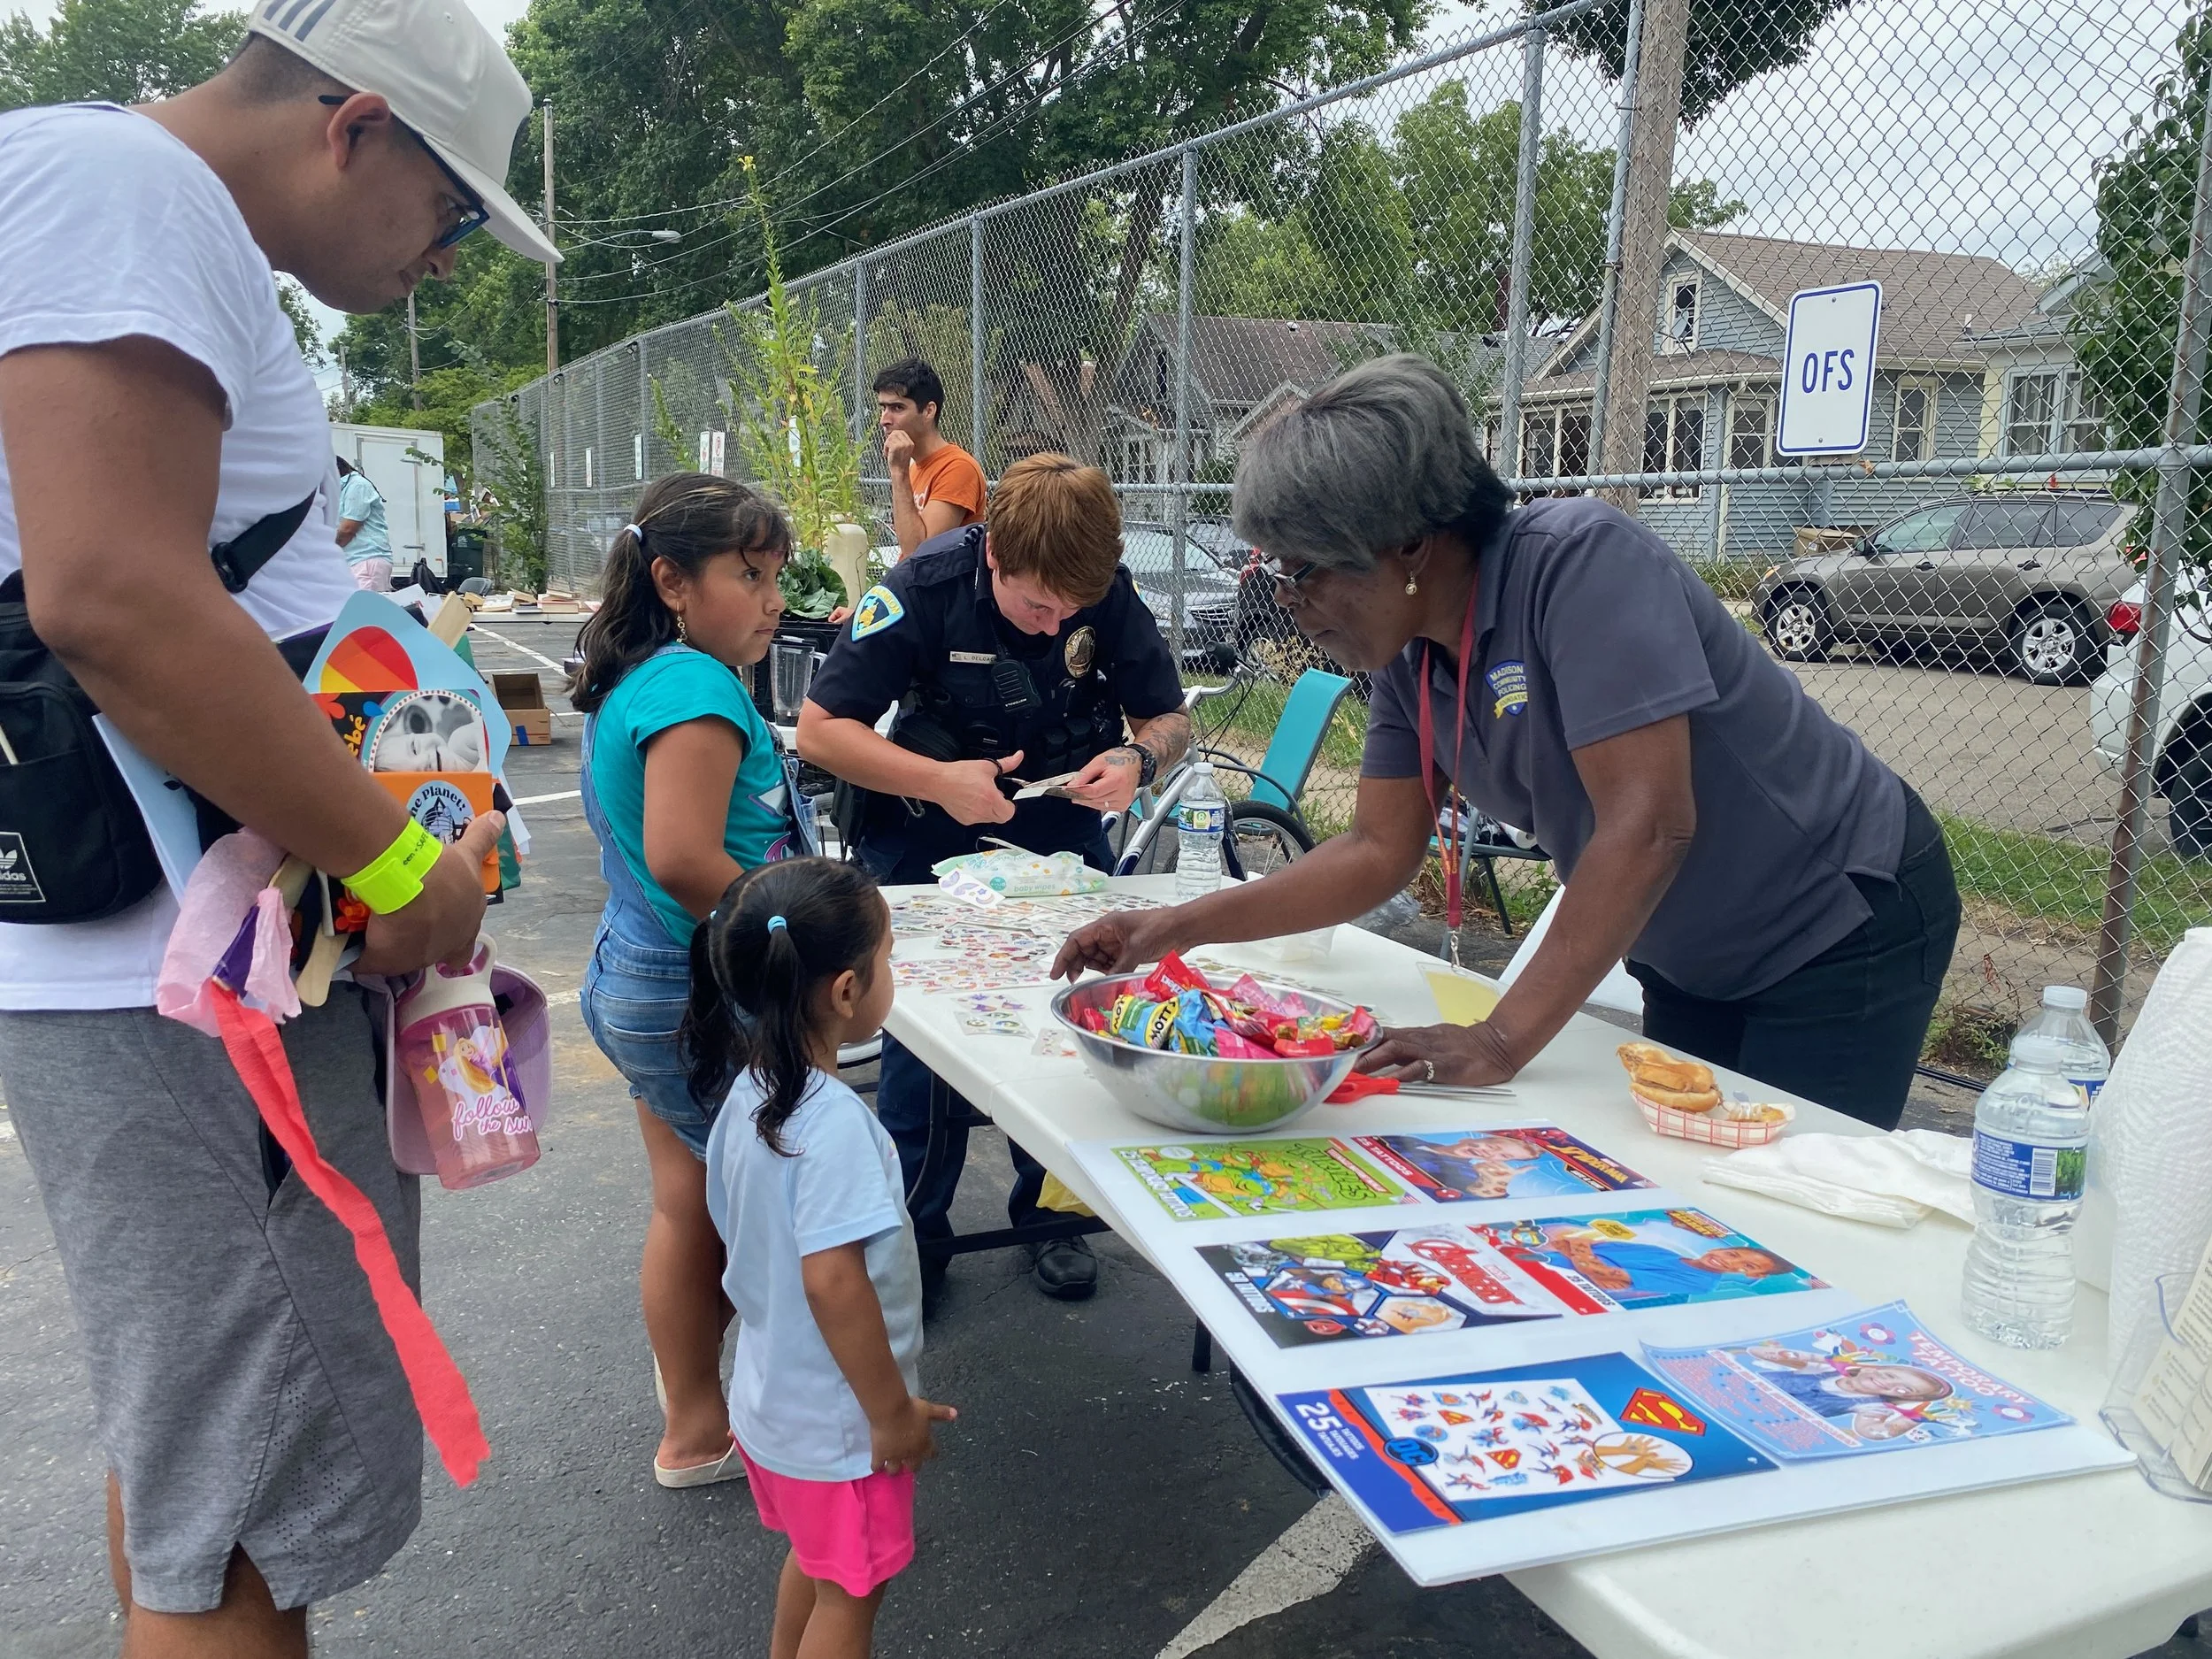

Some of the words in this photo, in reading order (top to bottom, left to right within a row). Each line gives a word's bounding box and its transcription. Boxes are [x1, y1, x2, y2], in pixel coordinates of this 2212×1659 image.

[1801, 349, 1855, 394] OFS
[1489, 664, 1524, 681] MADISON
[344, 714, 366, 757] ebé
[421, 785, 466, 811] Planet!
[451, 1094, 520, 1141] follow
[478, 1118, 502, 1136] the
[1372, 1147, 1414, 1177] TATTOOS
[1908, 1330, 2036, 1405] TEMPORARY
[1910, 1348, 1996, 1397] TATTOO
[1294, 1402, 1343, 1431] 25
[1388, 1438, 1433, 1465] DC
